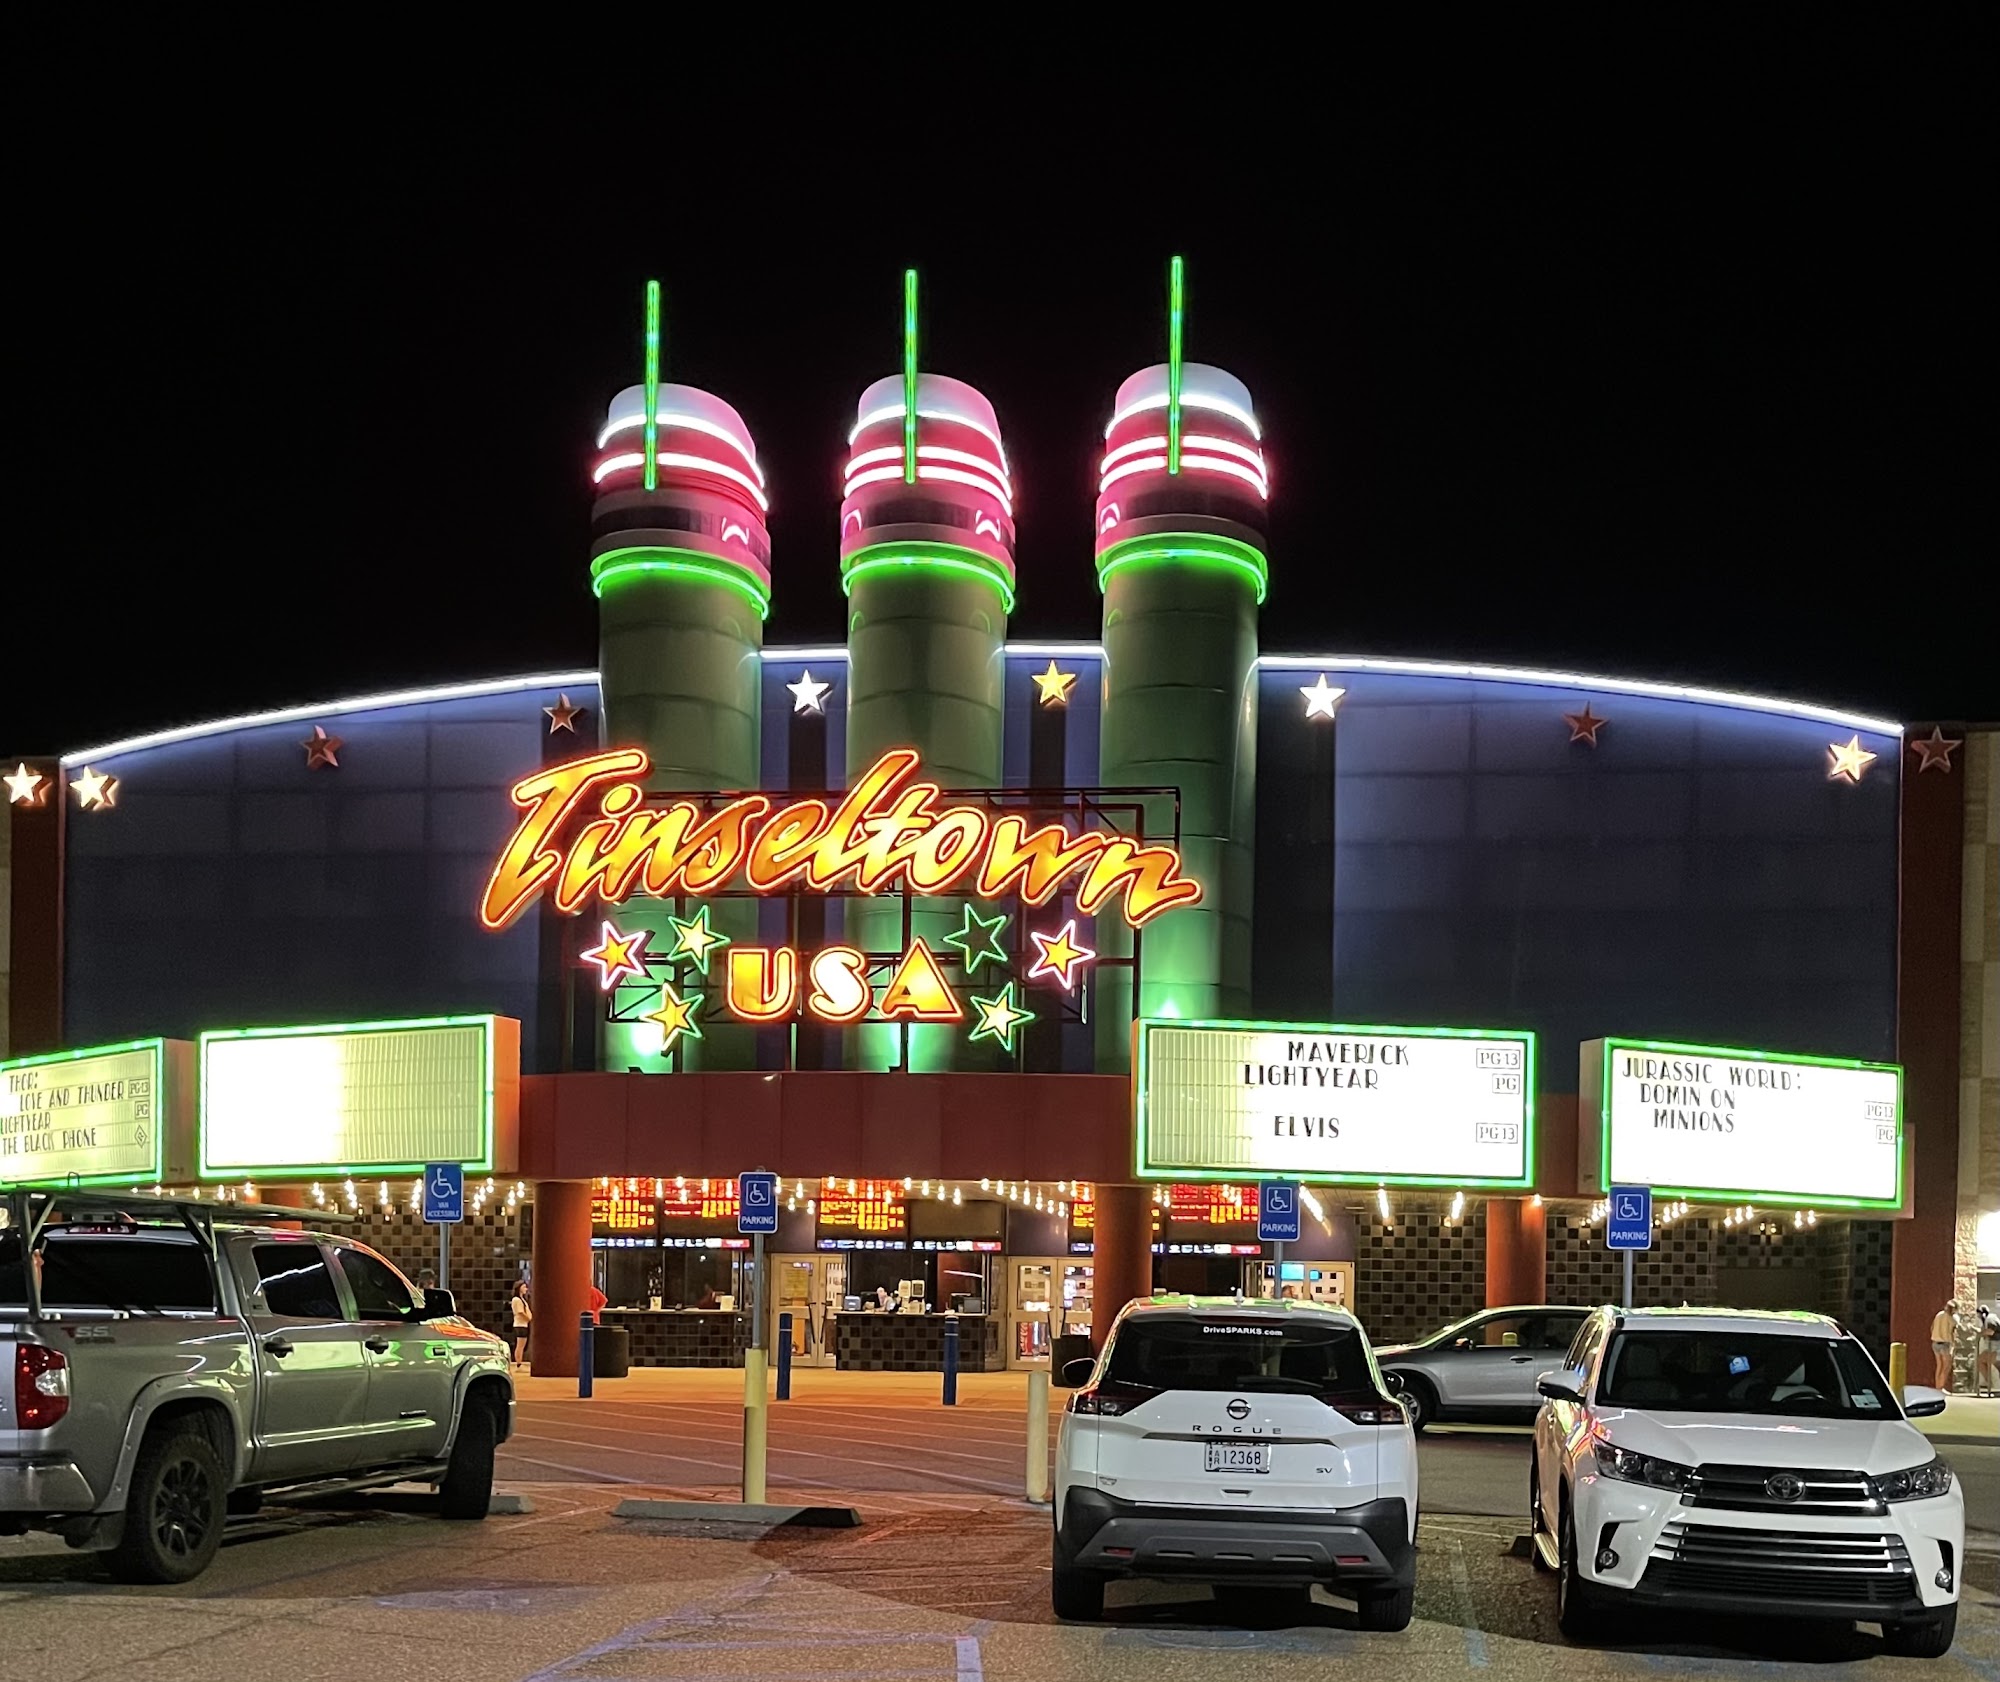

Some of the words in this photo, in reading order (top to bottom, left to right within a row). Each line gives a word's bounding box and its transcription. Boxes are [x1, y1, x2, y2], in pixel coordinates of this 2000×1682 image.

[480, 748, 1203, 929] Tinseltown
[726, 935, 962, 1021] USA
[1287, 1041, 1409, 1067] MAVERICK
[1244, 1064, 1379, 1090] LIGHTYEAR
[1622, 1057, 1713, 1083] JURASSIC
[20, 1091, 42, 1112] LOVE
[49, 1087, 70, 1109] AND
[77, 1080, 124, 1106] THUNDER
[1495, 1078, 1517, 1091] PG
[136, 1103, 148, 1116] PG
[1653, 1108, 1734, 1133] MINIONS
[0, 1111, 51, 1135] LIGHTYEAR
[1274, 1115, 1340, 1138] ELVIS
[1878, 1128, 1894, 1141] PG
[3, 1136, 19, 1155] THE
[62, 1128, 97, 1149] PHONE
[741, 1215, 775, 1225] PARKING
[1261, 1222, 1297, 1234] PARKING
[1610, 1231, 1648, 1241] PARKING
[1203, 1326, 1284, 1337] DriveSPARKS.com
[1192, 1425, 1282, 1435] ROGUE
[1223, 1450, 1261, 1465] 12368
